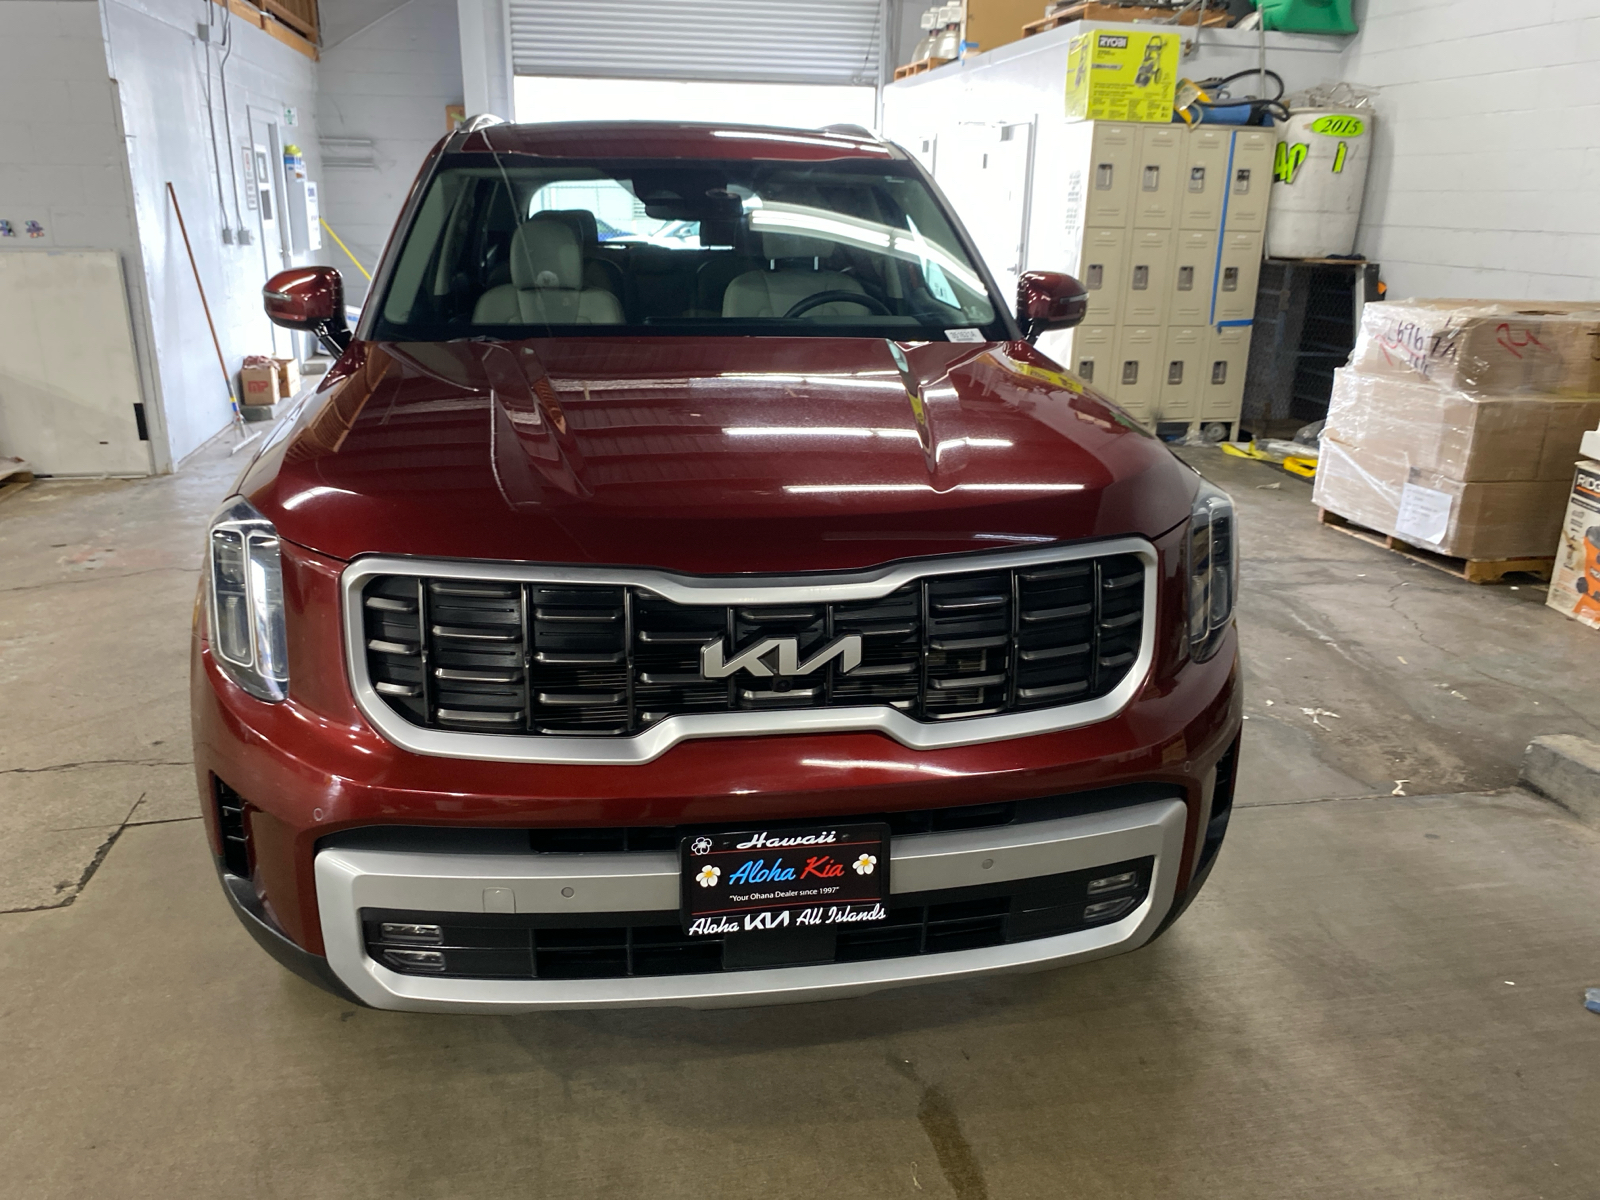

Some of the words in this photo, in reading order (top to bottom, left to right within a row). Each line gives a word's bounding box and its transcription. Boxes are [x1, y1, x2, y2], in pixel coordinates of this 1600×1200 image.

[1099, 36, 1127, 47] RYOBI
[1320, 118, 1361, 134] 2015
[701, 635, 862, 680] KIA
[736, 830, 837, 850] Hawaii
[728, 857, 796, 885] Aloha
[800, 855, 846, 880] Kia
[729, 894, 749, 903] "Your
[750, 892, 774, 900] Ohana
[775, 890, 798, 898] Dealer
[819, 886, 840, 895] 1997"
[688, 916, 740, 936] Aloha
[744, 910, 790, 931] KIA
[796, 907, 823, 926] All
[825, 903, 887, 924] Islands
